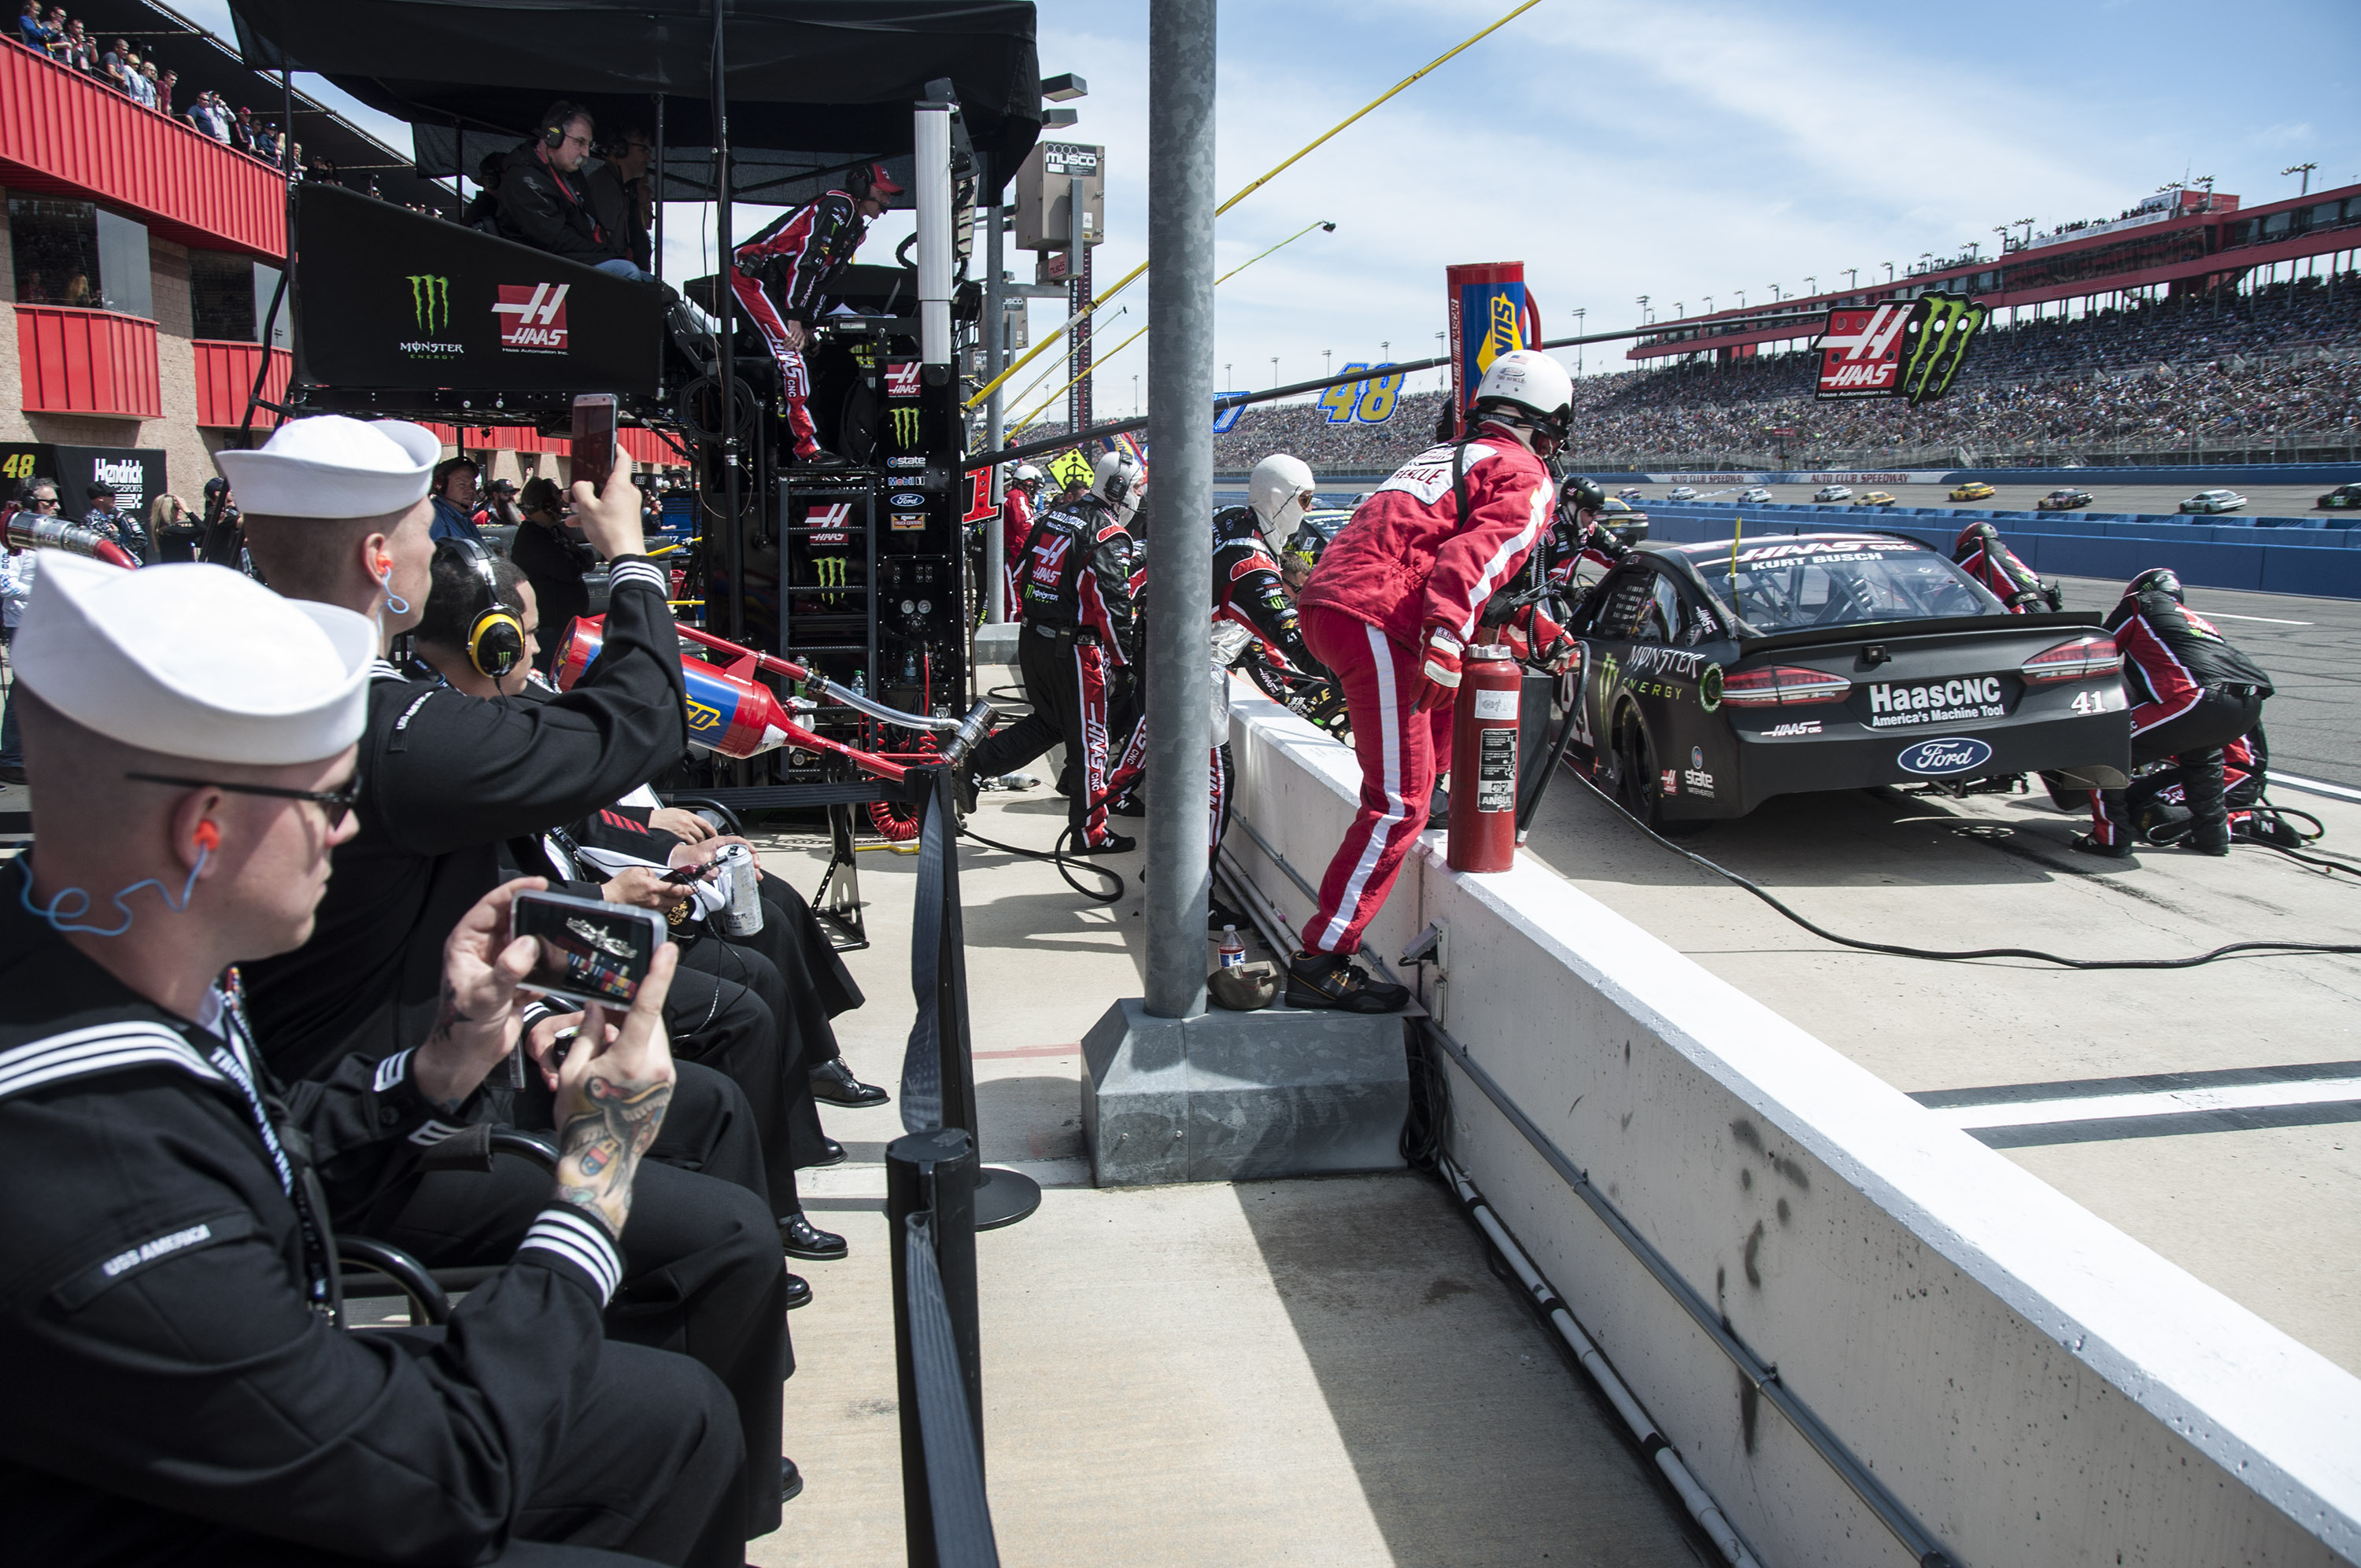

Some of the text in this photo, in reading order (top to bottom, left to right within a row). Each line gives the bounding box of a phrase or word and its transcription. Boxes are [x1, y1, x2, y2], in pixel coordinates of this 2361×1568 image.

[501, 327, 568, 346] HAAS
[400, 341, 464, 354] MONSTER
[1820, 363, 1898, 387] HAAS
[787, 379, 797, 398] CNC
[888, 385, 921, 393] HAAS
[1317, 363, 1406, 422] 48
[2, 454, 35, 478] 48
[897, 456, 926, 465] state
[94, 458, 143, 484] Hendrick
[1392, 468, 1447, 485] RESCUE
[1709, 474, 1745, 483] SPEEDWAY
[1812, 474, 1908, 482] AUTO CLUB SPEEDWAY
[888, 477, 914, 486] Mobil
[1695, 541, 1920, 567] HAAS CNC
[1751, 552, 1883, 571] KURT BUSCH
[1033, 566, 1061, 583] HAAS
[1287, 633, 1298, 644] 41
[1626, 645, 1706, 679] MONSTER
[1621, 677, 1683, 700] ENERGY
[1869, 677, 2001, 714] HaasCNC
[2071, 690, 2107, 716] 41
[1872, 704, 2004, 727] America's Machine Tool
[1761, 721, 1821, 736] HAAS
[1126, 748, 1139, 765] CNC
[1916, 741, 1974, 769] Ford
[1091, 772, 1099, 791] CNC
[1685, 769, 1713, 788] state
[1481, 795, 1513, 805] ANSUL
